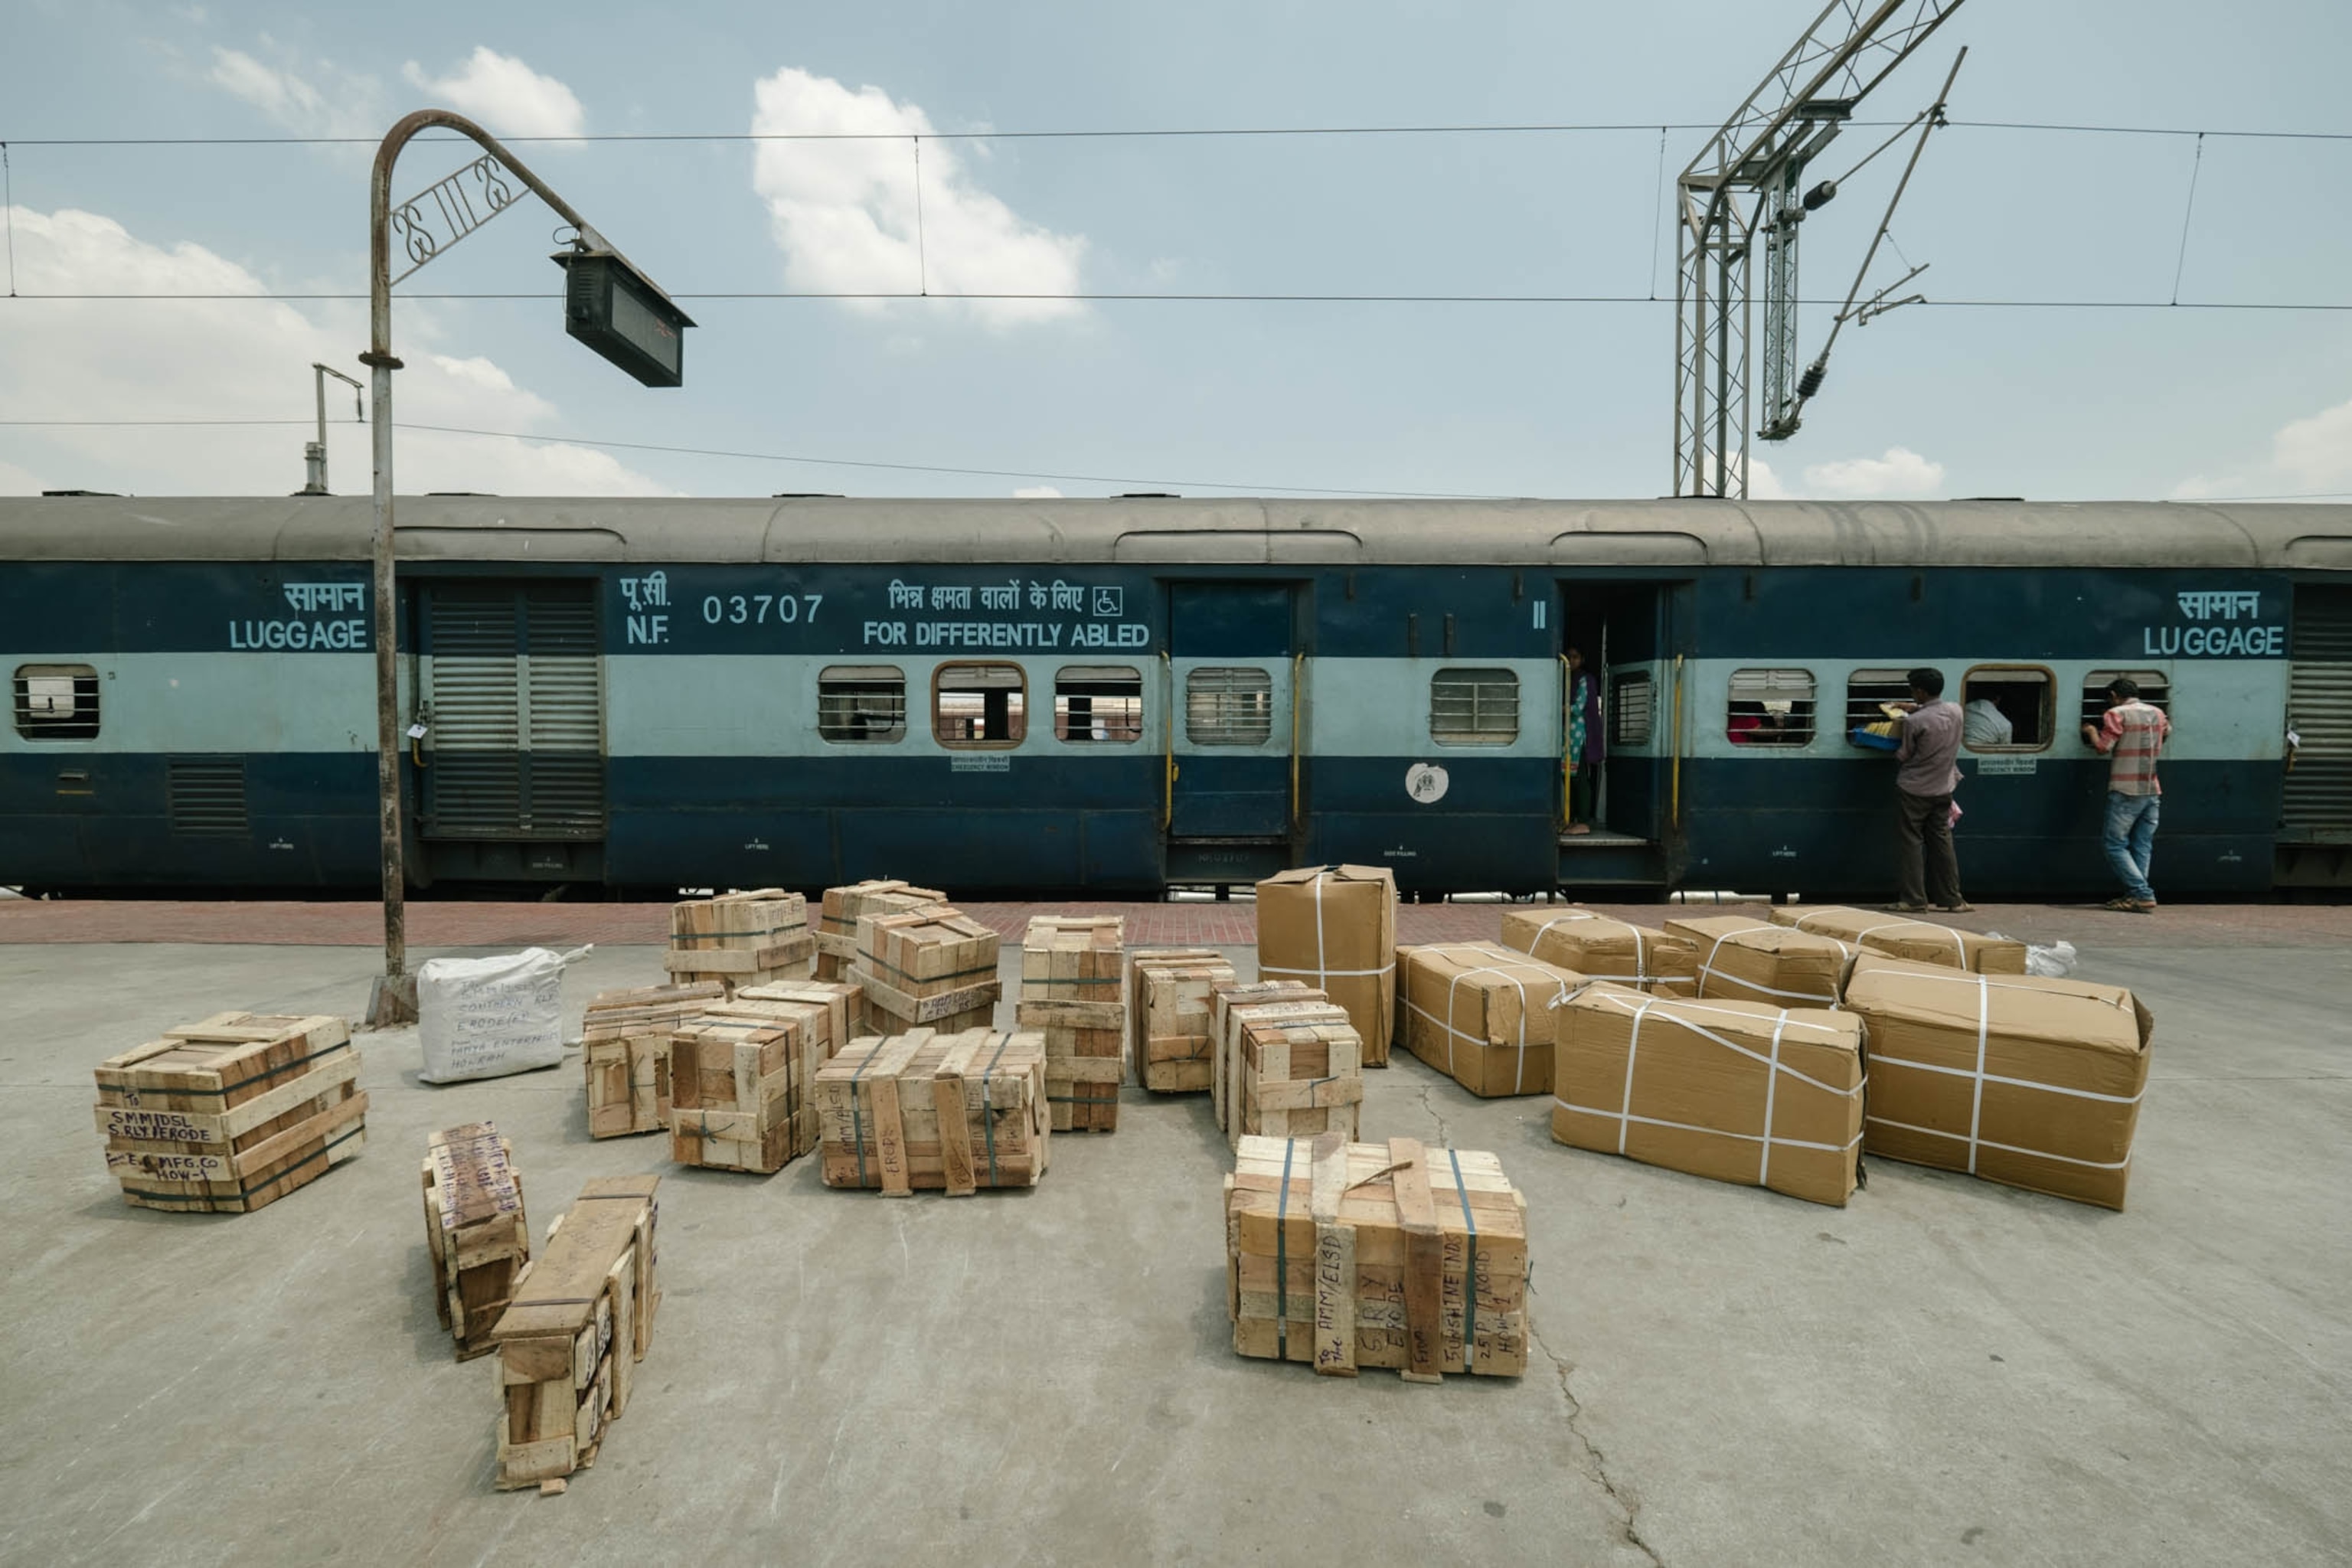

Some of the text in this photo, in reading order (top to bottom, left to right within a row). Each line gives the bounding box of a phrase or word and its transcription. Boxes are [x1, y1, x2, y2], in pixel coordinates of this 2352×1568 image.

[283, 583, 365, 612] सामान
[703, 595, 823, 624] 03707
[887, 579, 1085, 612] भिन्न क्षमता वालों के लिए
[2177, 591, 2260, 619] सामान
[230, 620, 367, 648] LUGGAGE
[626, 615, 670, 644] N.F.
[864, 621, 1149, 647] FOR DIFFERENTLY ABLED
[2145, 627, 2283, 655] LUGGAGE
